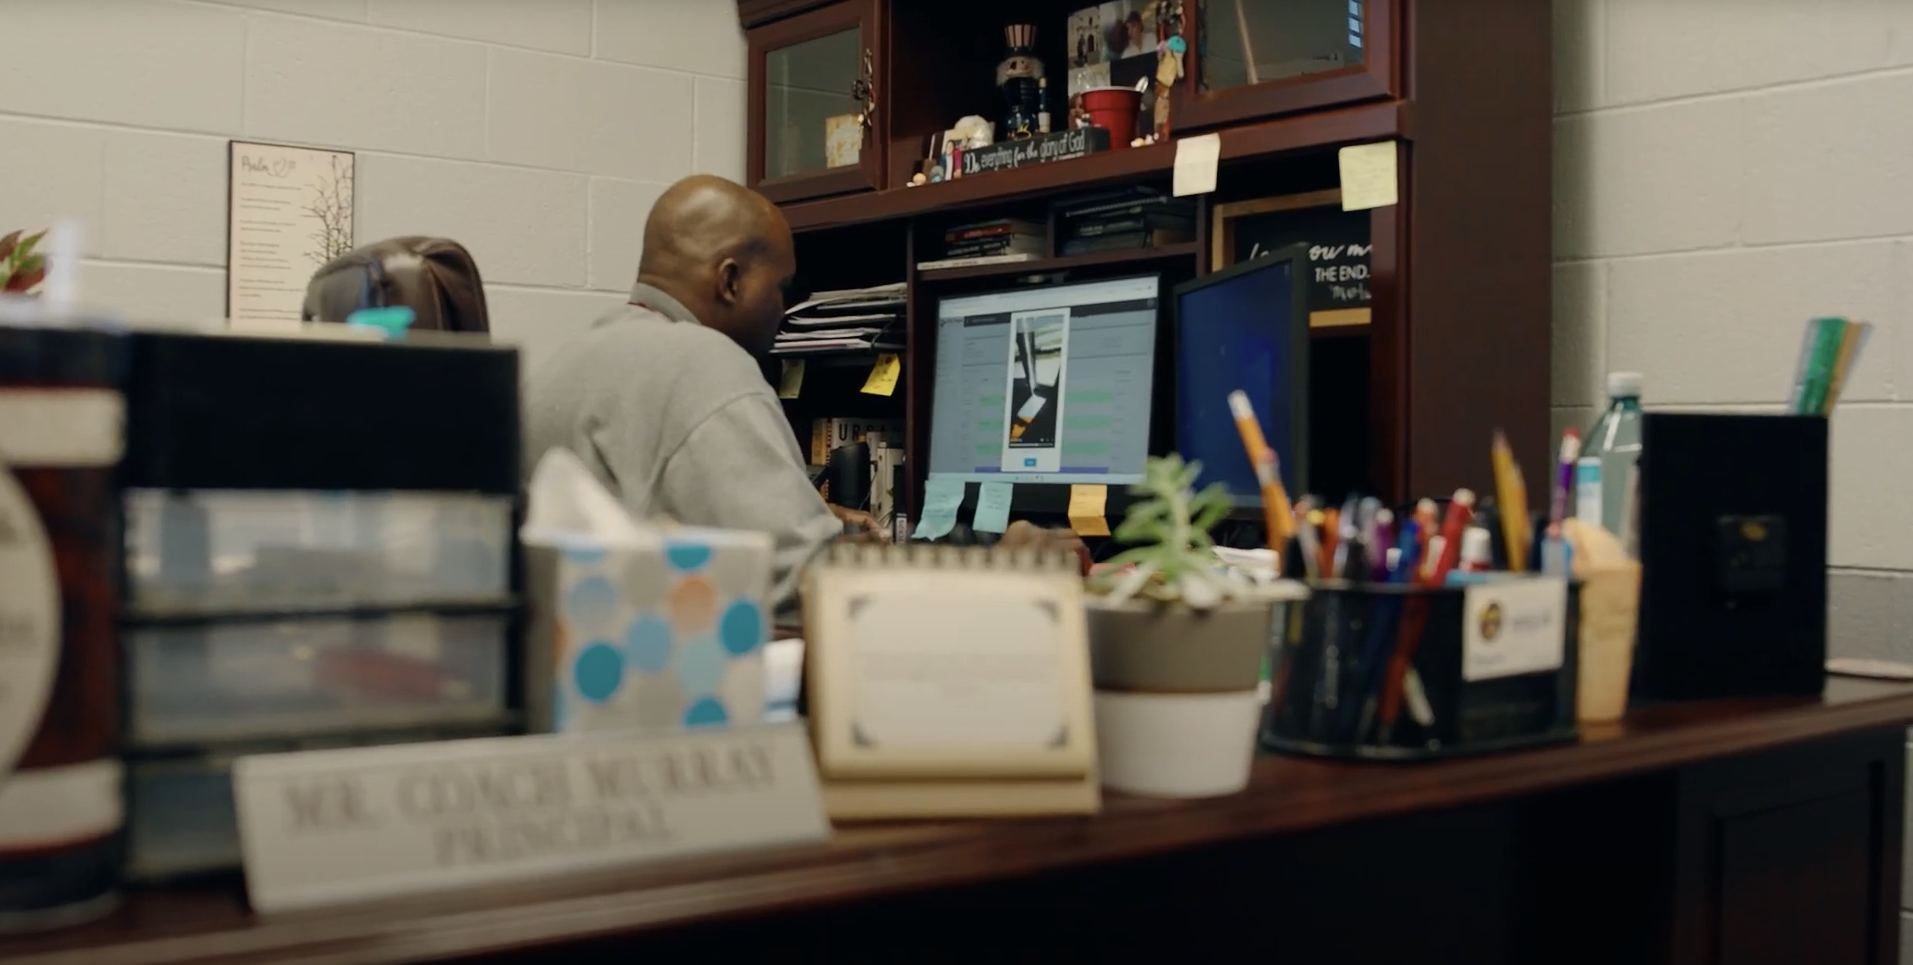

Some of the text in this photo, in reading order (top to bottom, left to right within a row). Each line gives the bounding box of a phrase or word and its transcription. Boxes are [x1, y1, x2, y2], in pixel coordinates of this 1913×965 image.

[981, 146, 1013, 171] everything
[1014, 146, 1026, 168] for
[1026, 140, 1039, 160] the
[1040, 138, 1058, 162] glory
[1058, 132, 1068, 154] of
[1068, 129, 1085, 152] God
[1315, 266, 1337, 282] THE
[283, 743, 776, 837] MR. COACH MURRAY
[433, 806, 673, 867] PRINCIPAL
